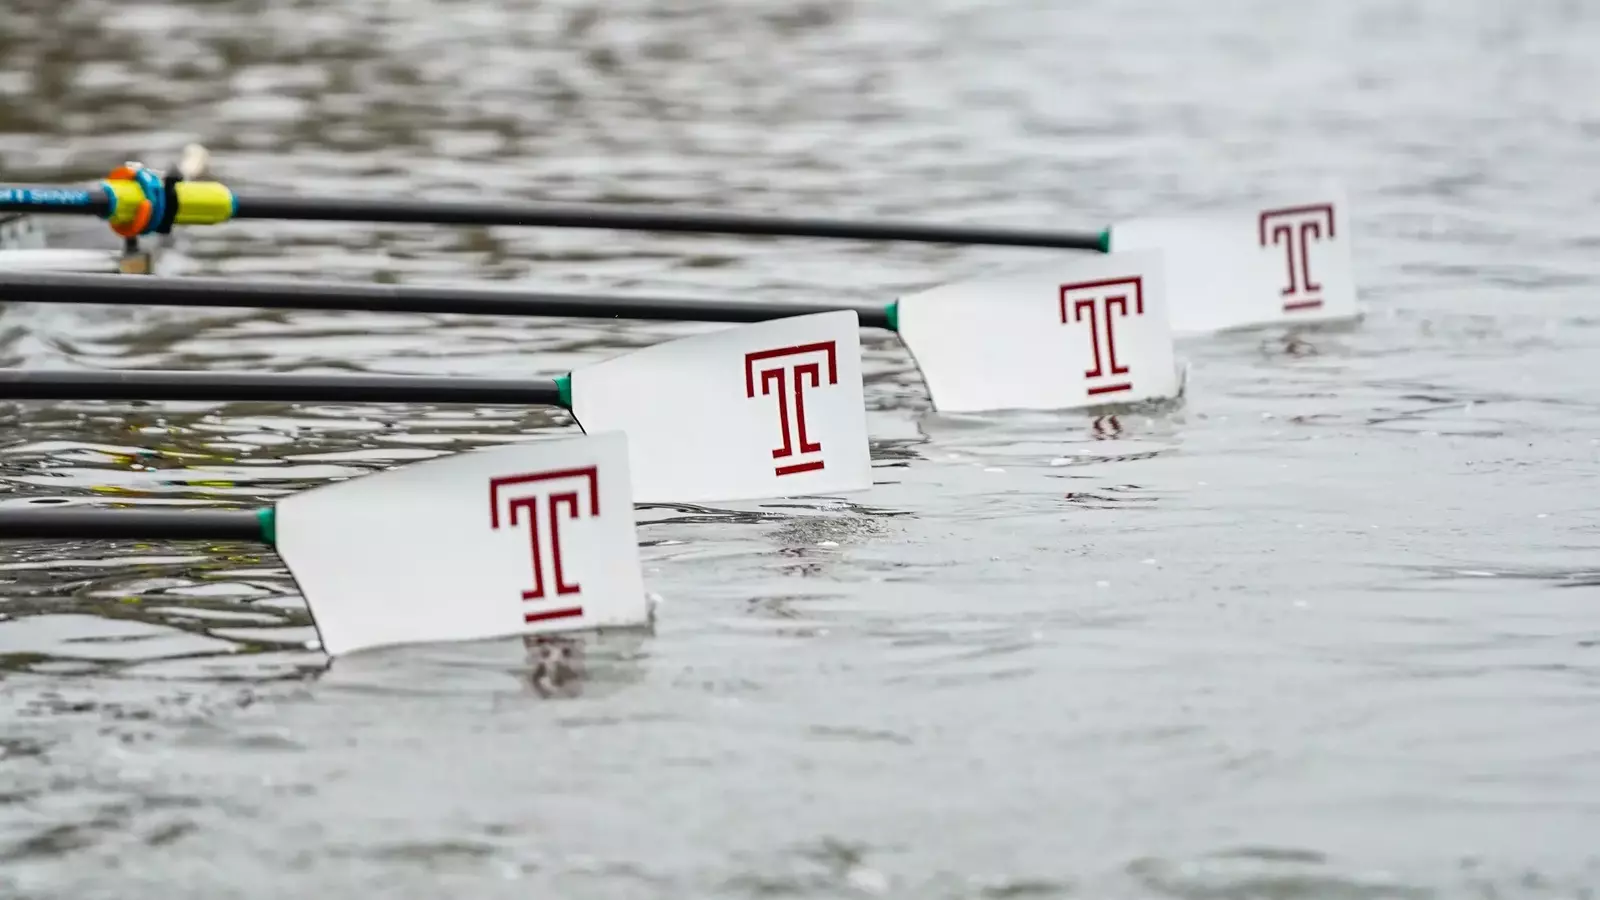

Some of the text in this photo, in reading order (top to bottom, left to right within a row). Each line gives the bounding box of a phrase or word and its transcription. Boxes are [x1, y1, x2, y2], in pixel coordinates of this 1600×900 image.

[1257, 202, 1336, 310] T
[1060, 275, 1144, 395] T
[744, 340, 838, 477] T
[489, 465, 600, 623] T
